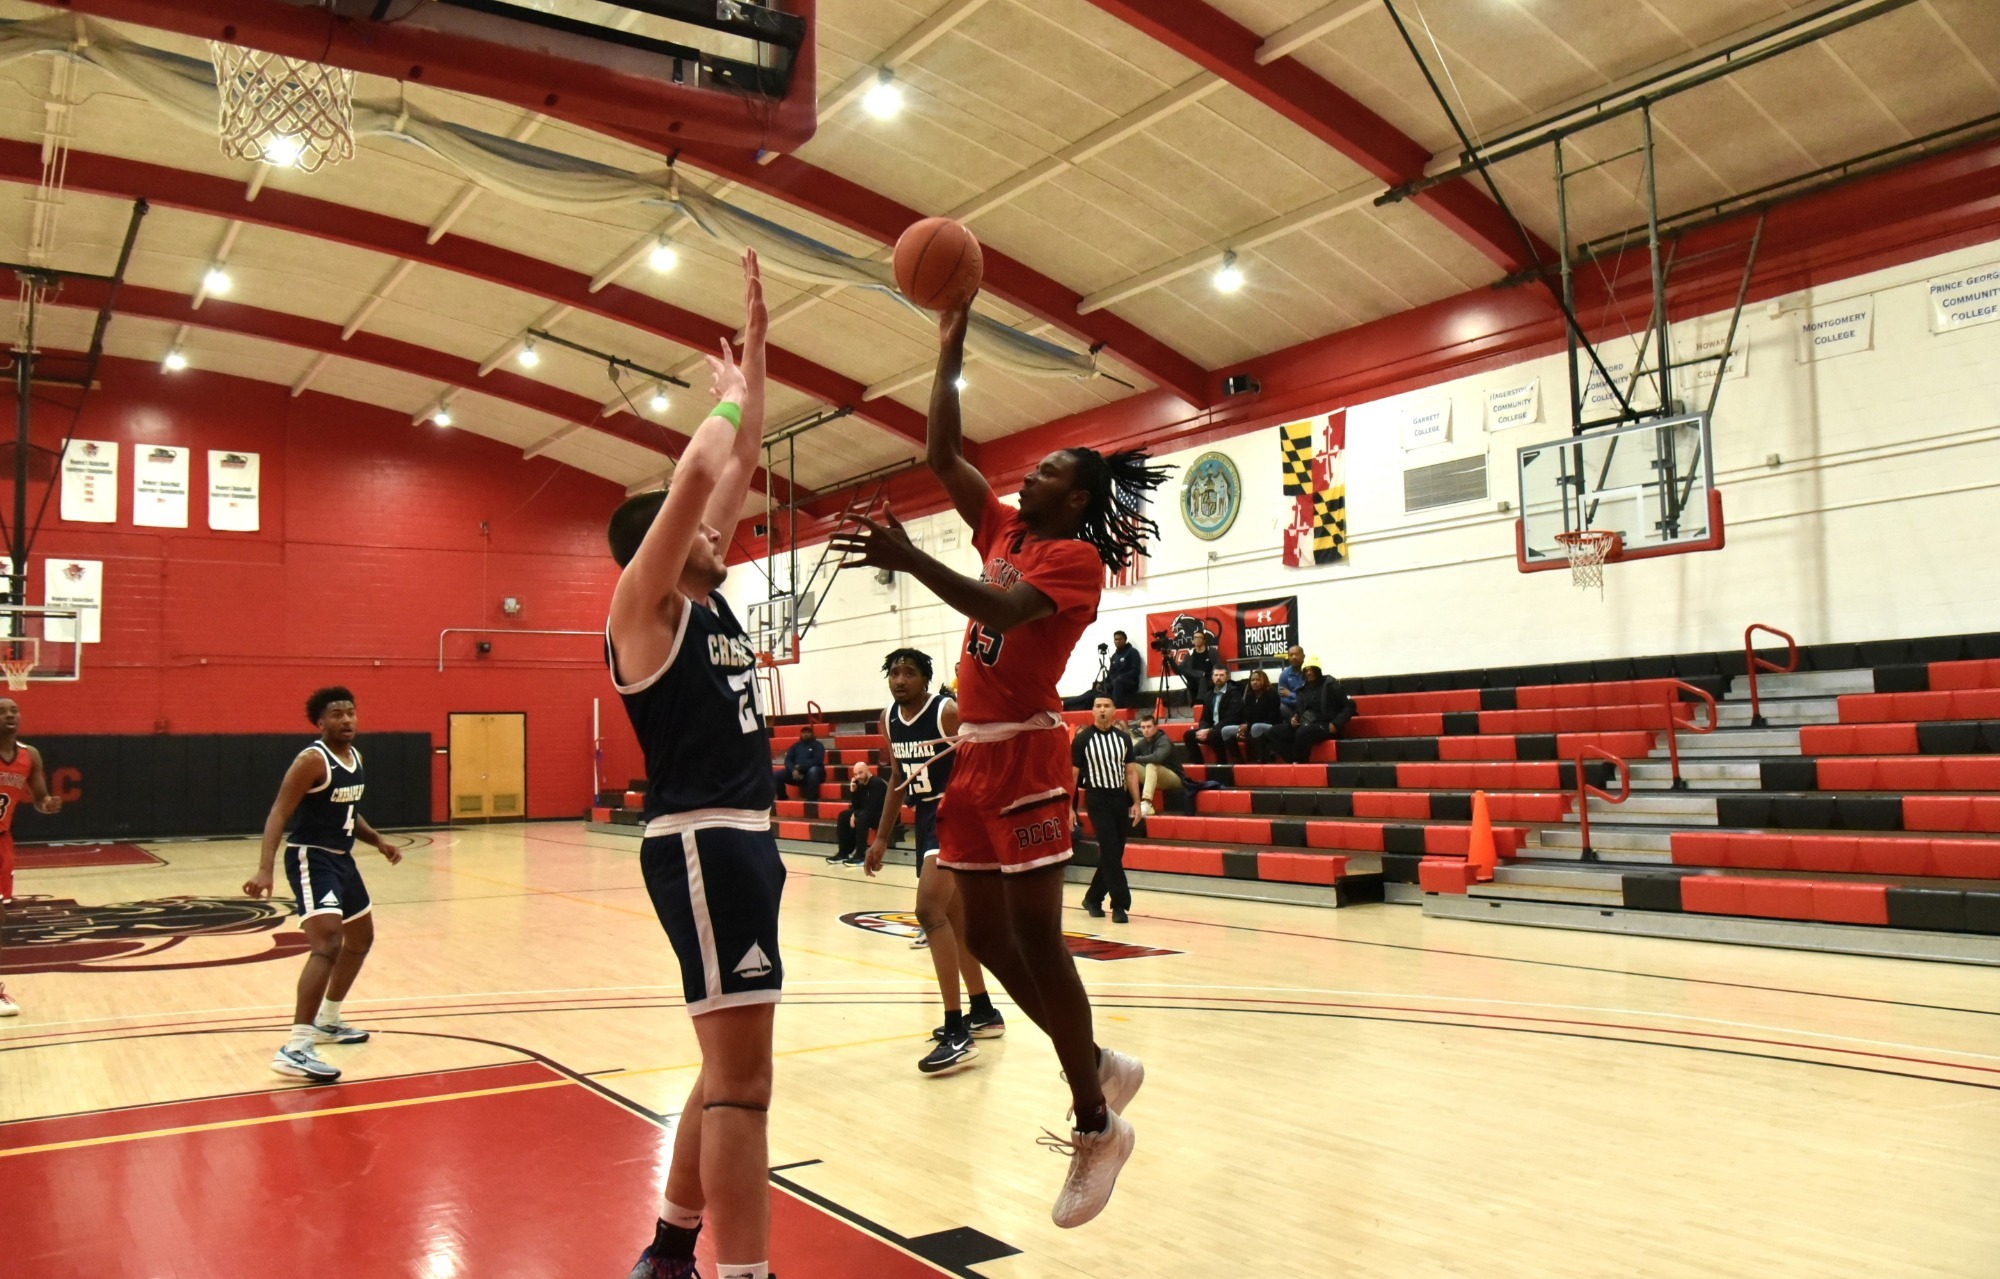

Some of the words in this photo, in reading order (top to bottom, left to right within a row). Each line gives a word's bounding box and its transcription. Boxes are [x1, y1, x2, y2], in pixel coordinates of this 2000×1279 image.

[1930, 280, 1963, 294] PRINCE
[1966, 271, 2000, 285] GEORG
[1951, 305, 1998, 321] COLLEGE
[1802, 312, 1866, 333] MONTGOMERY
[1696, 338, 1727, 351] HOWAR
[1814, 330, 1856, 345] COLLEGE
[1590, 363, 1624, 376] HAFORD
[1697, 366, 1734, 379] COLLGE
[1489, 386, 1534, 401] HAGERSTON
[1492, 398, 1532, 413] COMMUNITY
[1412, 413, 1440, 425] GARRETT
[1498, 412, 1527, 424] COLLEGE
[1414, 426, 1440, 437] COLLEGE
[1245, 624, 1288, 644] PROTECT
[1245, 643, 1262, 657] THIS
[1263, 640, 1288, 656] HOUSE
[342, 804, 355, 836] 4
